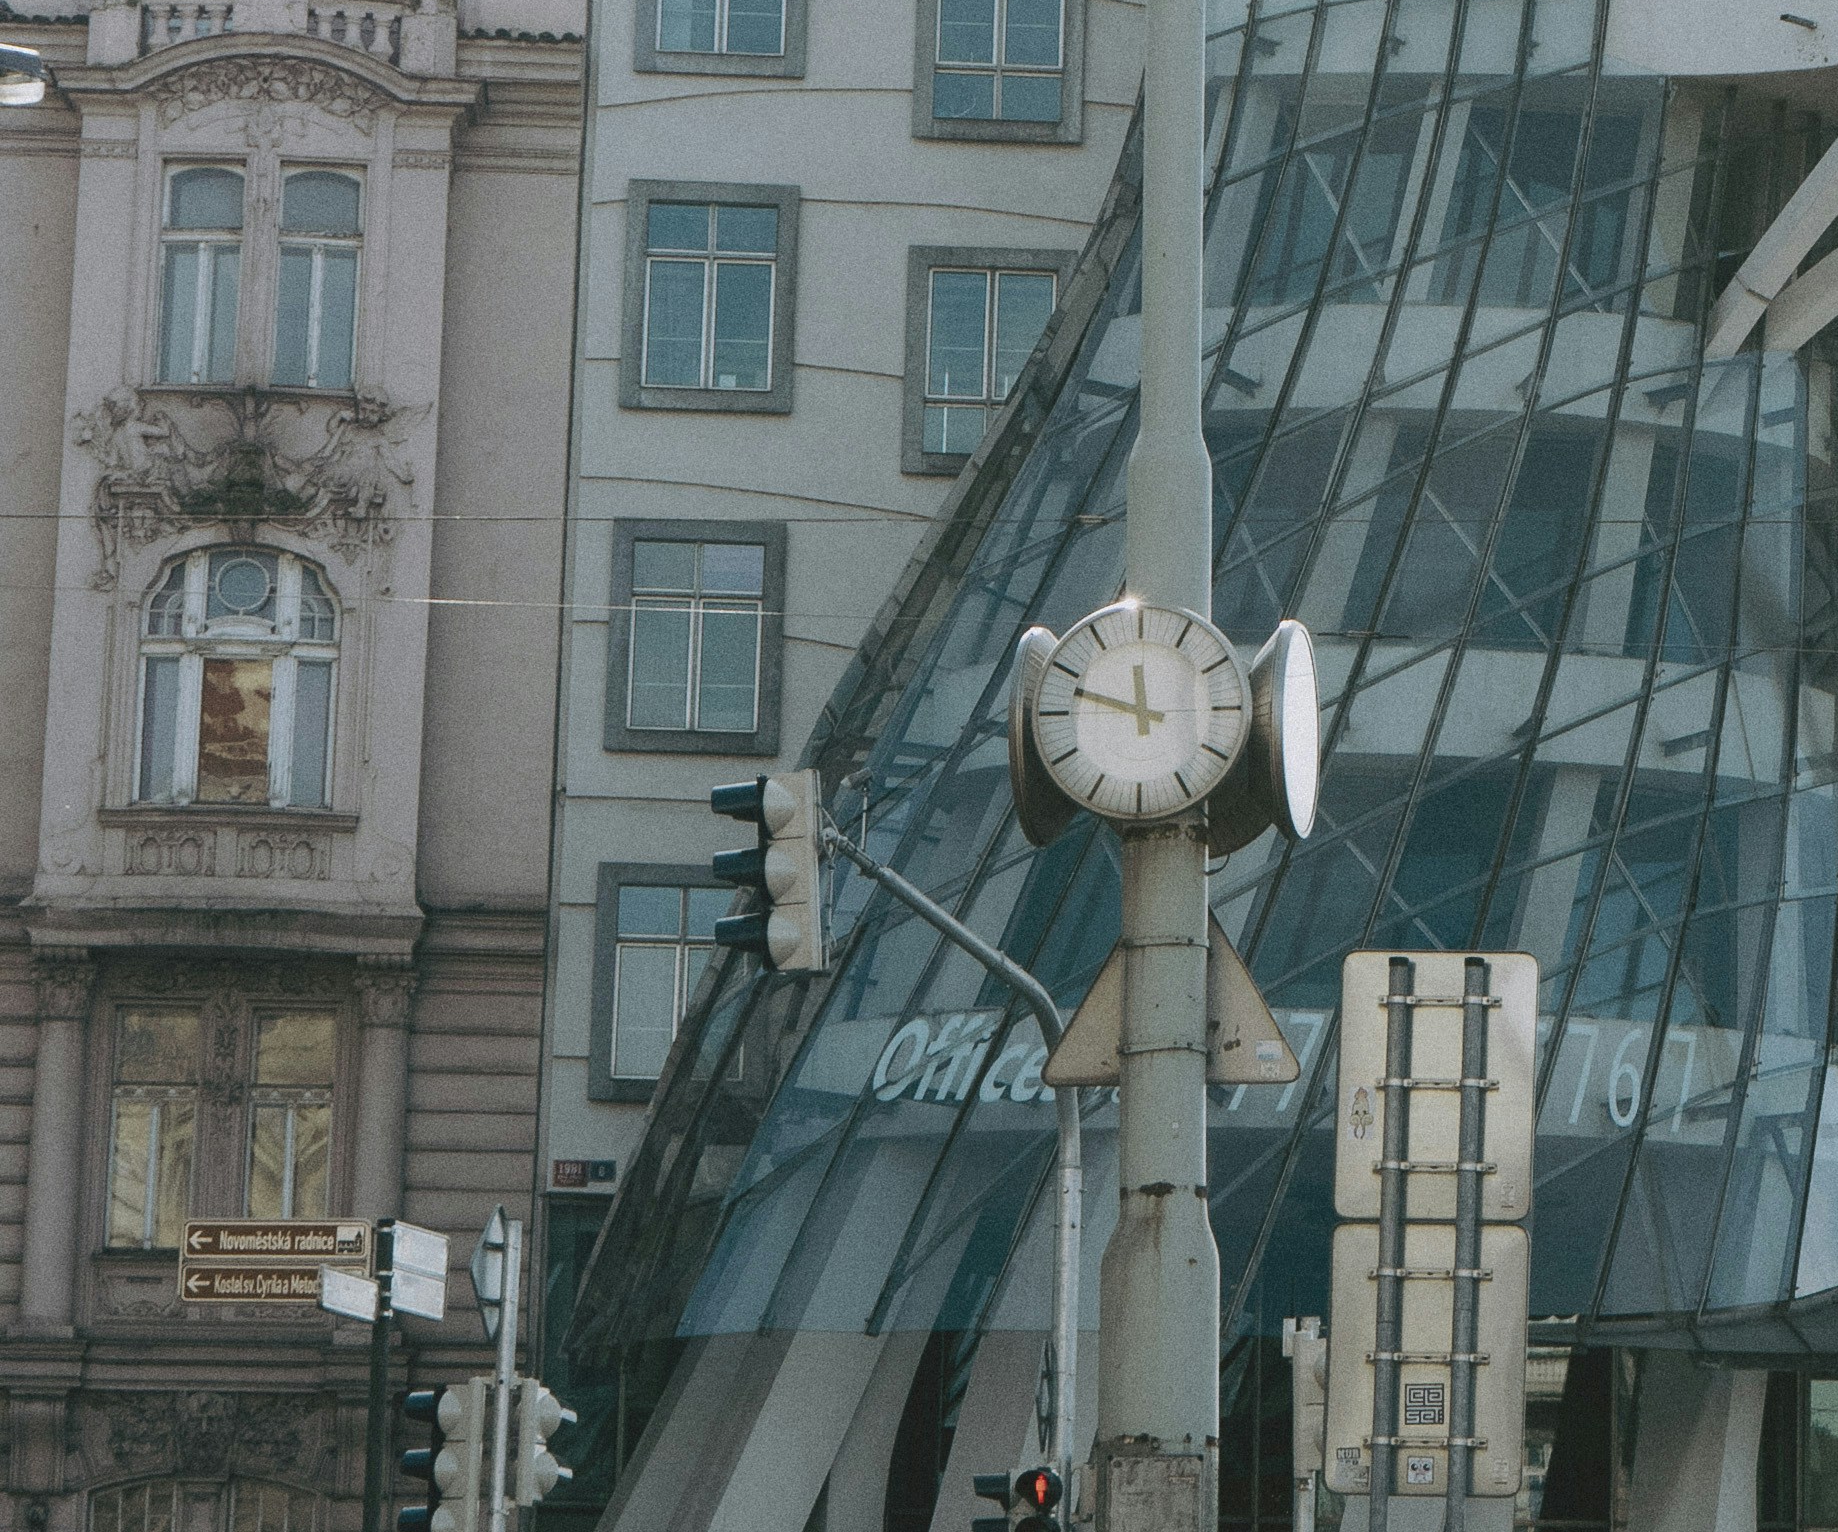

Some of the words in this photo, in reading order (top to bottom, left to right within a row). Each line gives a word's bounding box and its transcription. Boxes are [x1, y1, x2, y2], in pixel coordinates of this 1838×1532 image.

[219, 1229, 292, 1251] Novoměstská
[294, 1230, 335, 1251] radnice
[214, 1273, 243, 1294] Kostel
